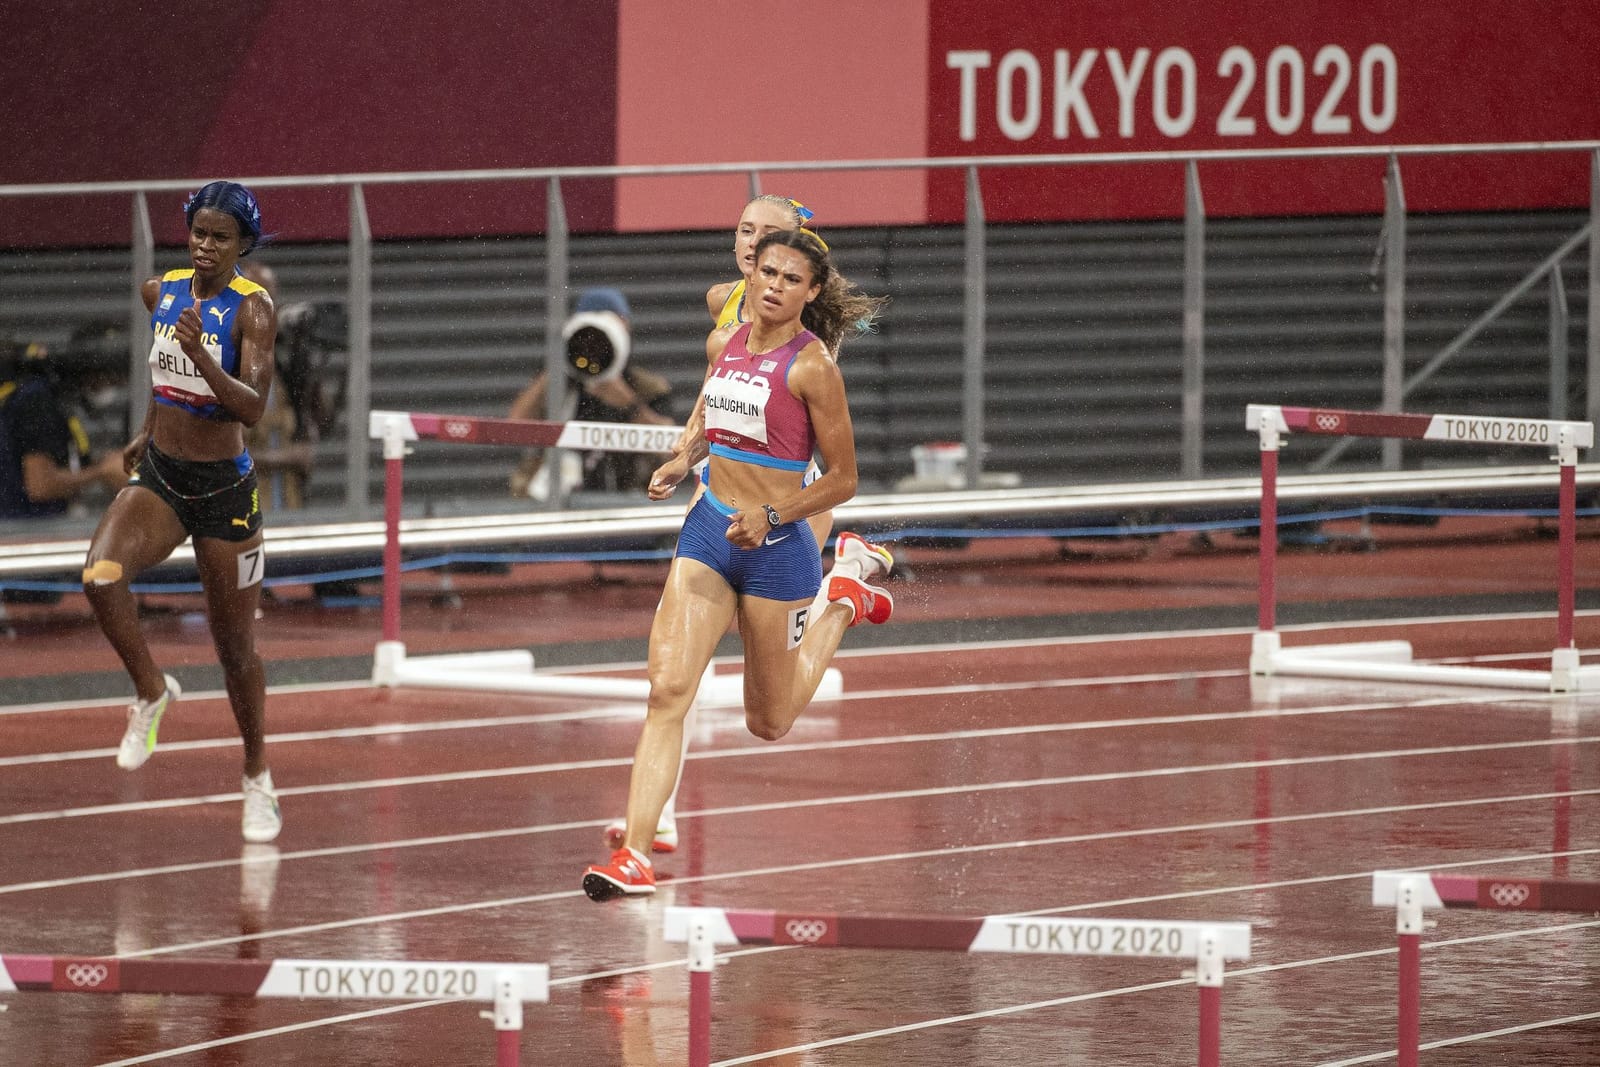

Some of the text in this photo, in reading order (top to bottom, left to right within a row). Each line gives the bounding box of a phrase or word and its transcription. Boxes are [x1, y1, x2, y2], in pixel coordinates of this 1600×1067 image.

[946, 43, 1399, 142] TOKYO 2020
[154, 321, 219, 346] BAROS
[705, 393, 759, 417] McLAUGHLIN
[580, 426, 640, 448] TOKYO
[1444, 419, 1549, 442] TOKYO 2020
[244, 550, 259, 582] 7
[793, 609, 808, 643] 5
[1007, 923, 1183, 954] TOKYO 2020
[295, 967, 478, 996] TOKYO 2020
